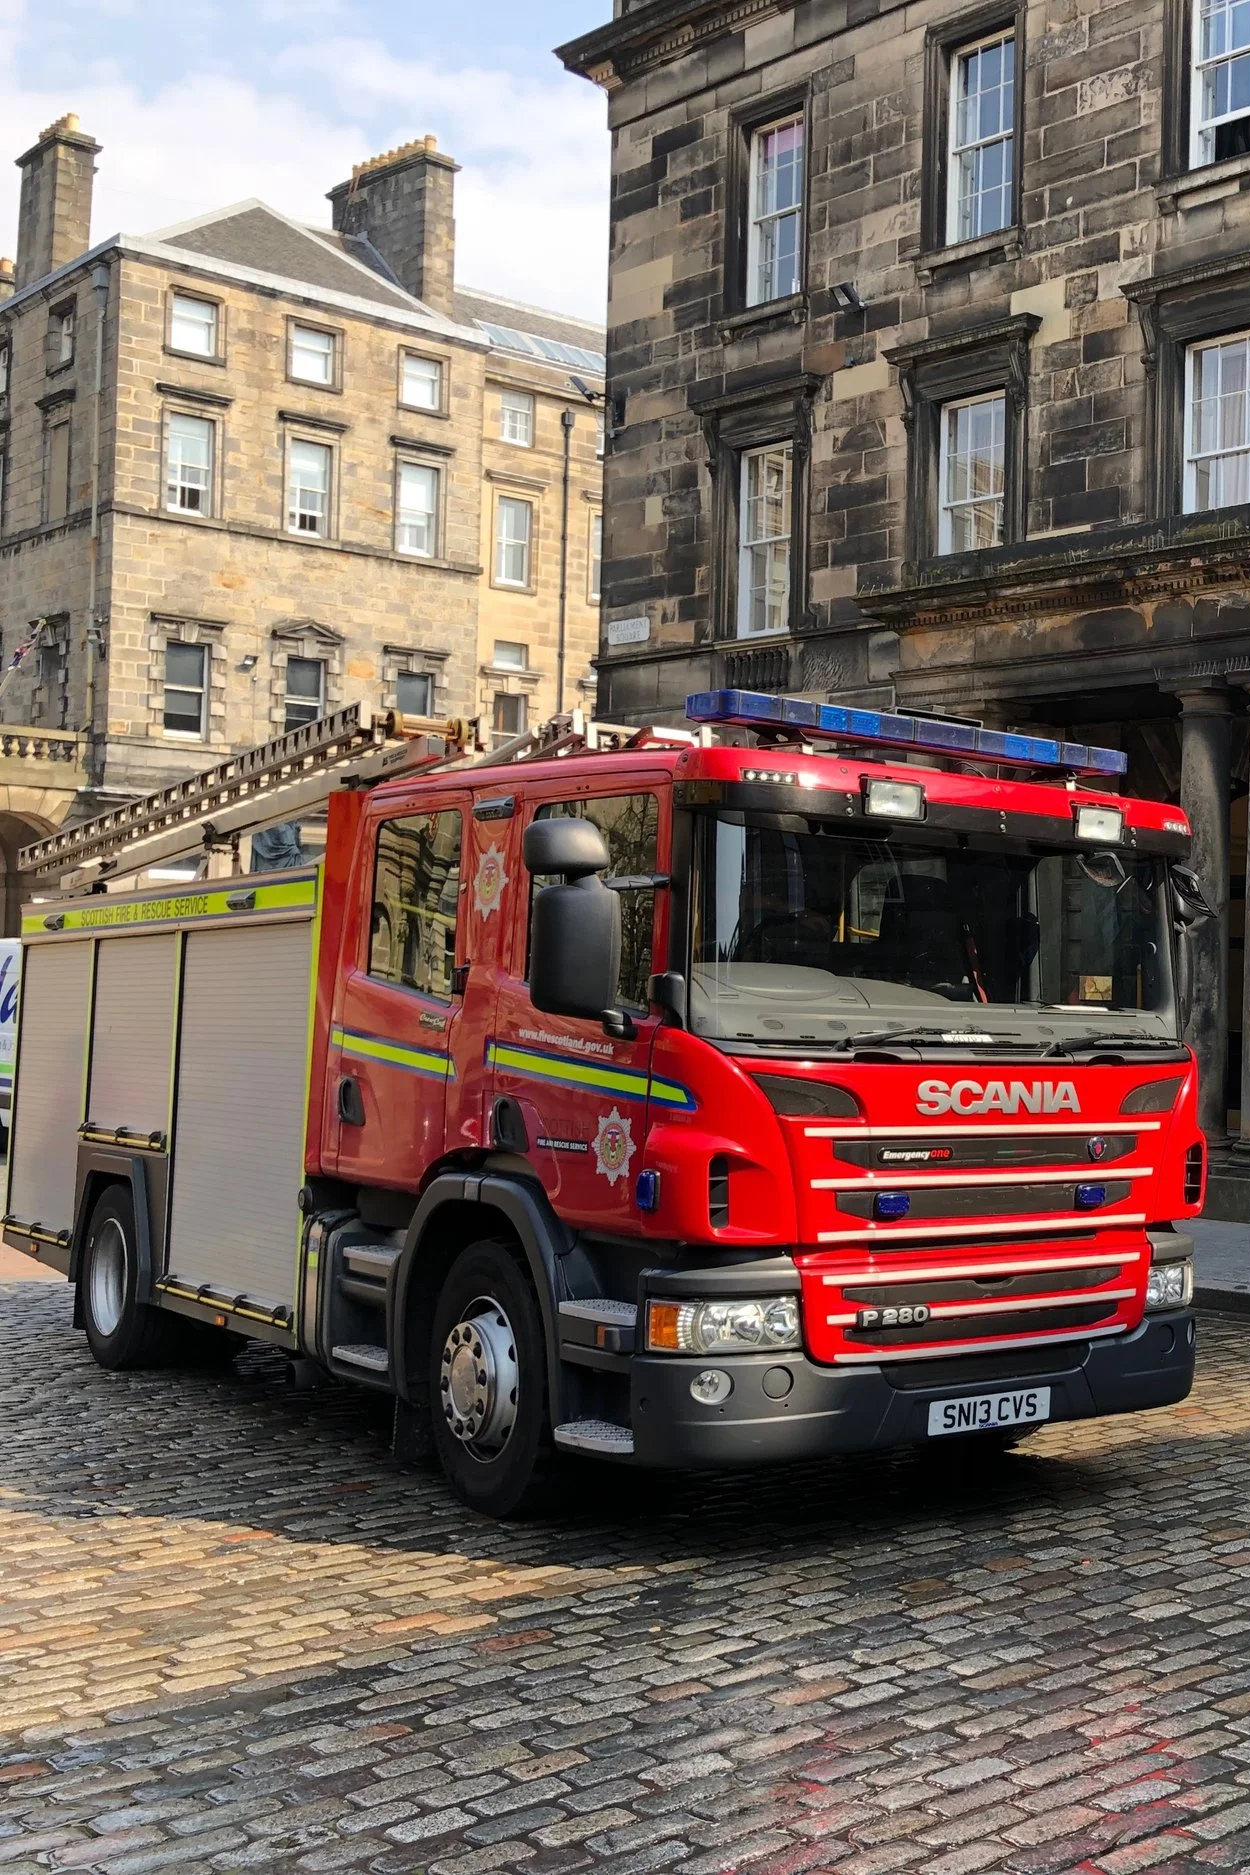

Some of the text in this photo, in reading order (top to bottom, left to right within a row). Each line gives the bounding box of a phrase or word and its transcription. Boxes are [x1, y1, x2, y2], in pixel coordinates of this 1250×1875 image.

[616, 630, 641, 642] SQUARE
[81, 896, 208, 926] SCOTTISH FIRE & RESCUE SERVICE
[519, 1028, 614, 1055] www.firescotland.gov.uk
[916, 1080, 1081, 1116] SCANIA
[537, 1138, 546, 1146] FIRE
[554, 1140, 569, 1149] RESCUE
[570, 1142, 588, 1151] SERVICE
[862, 1306, 929, 1327] P 280
[943, 1393, 1037, 1429] SN13 CVS
